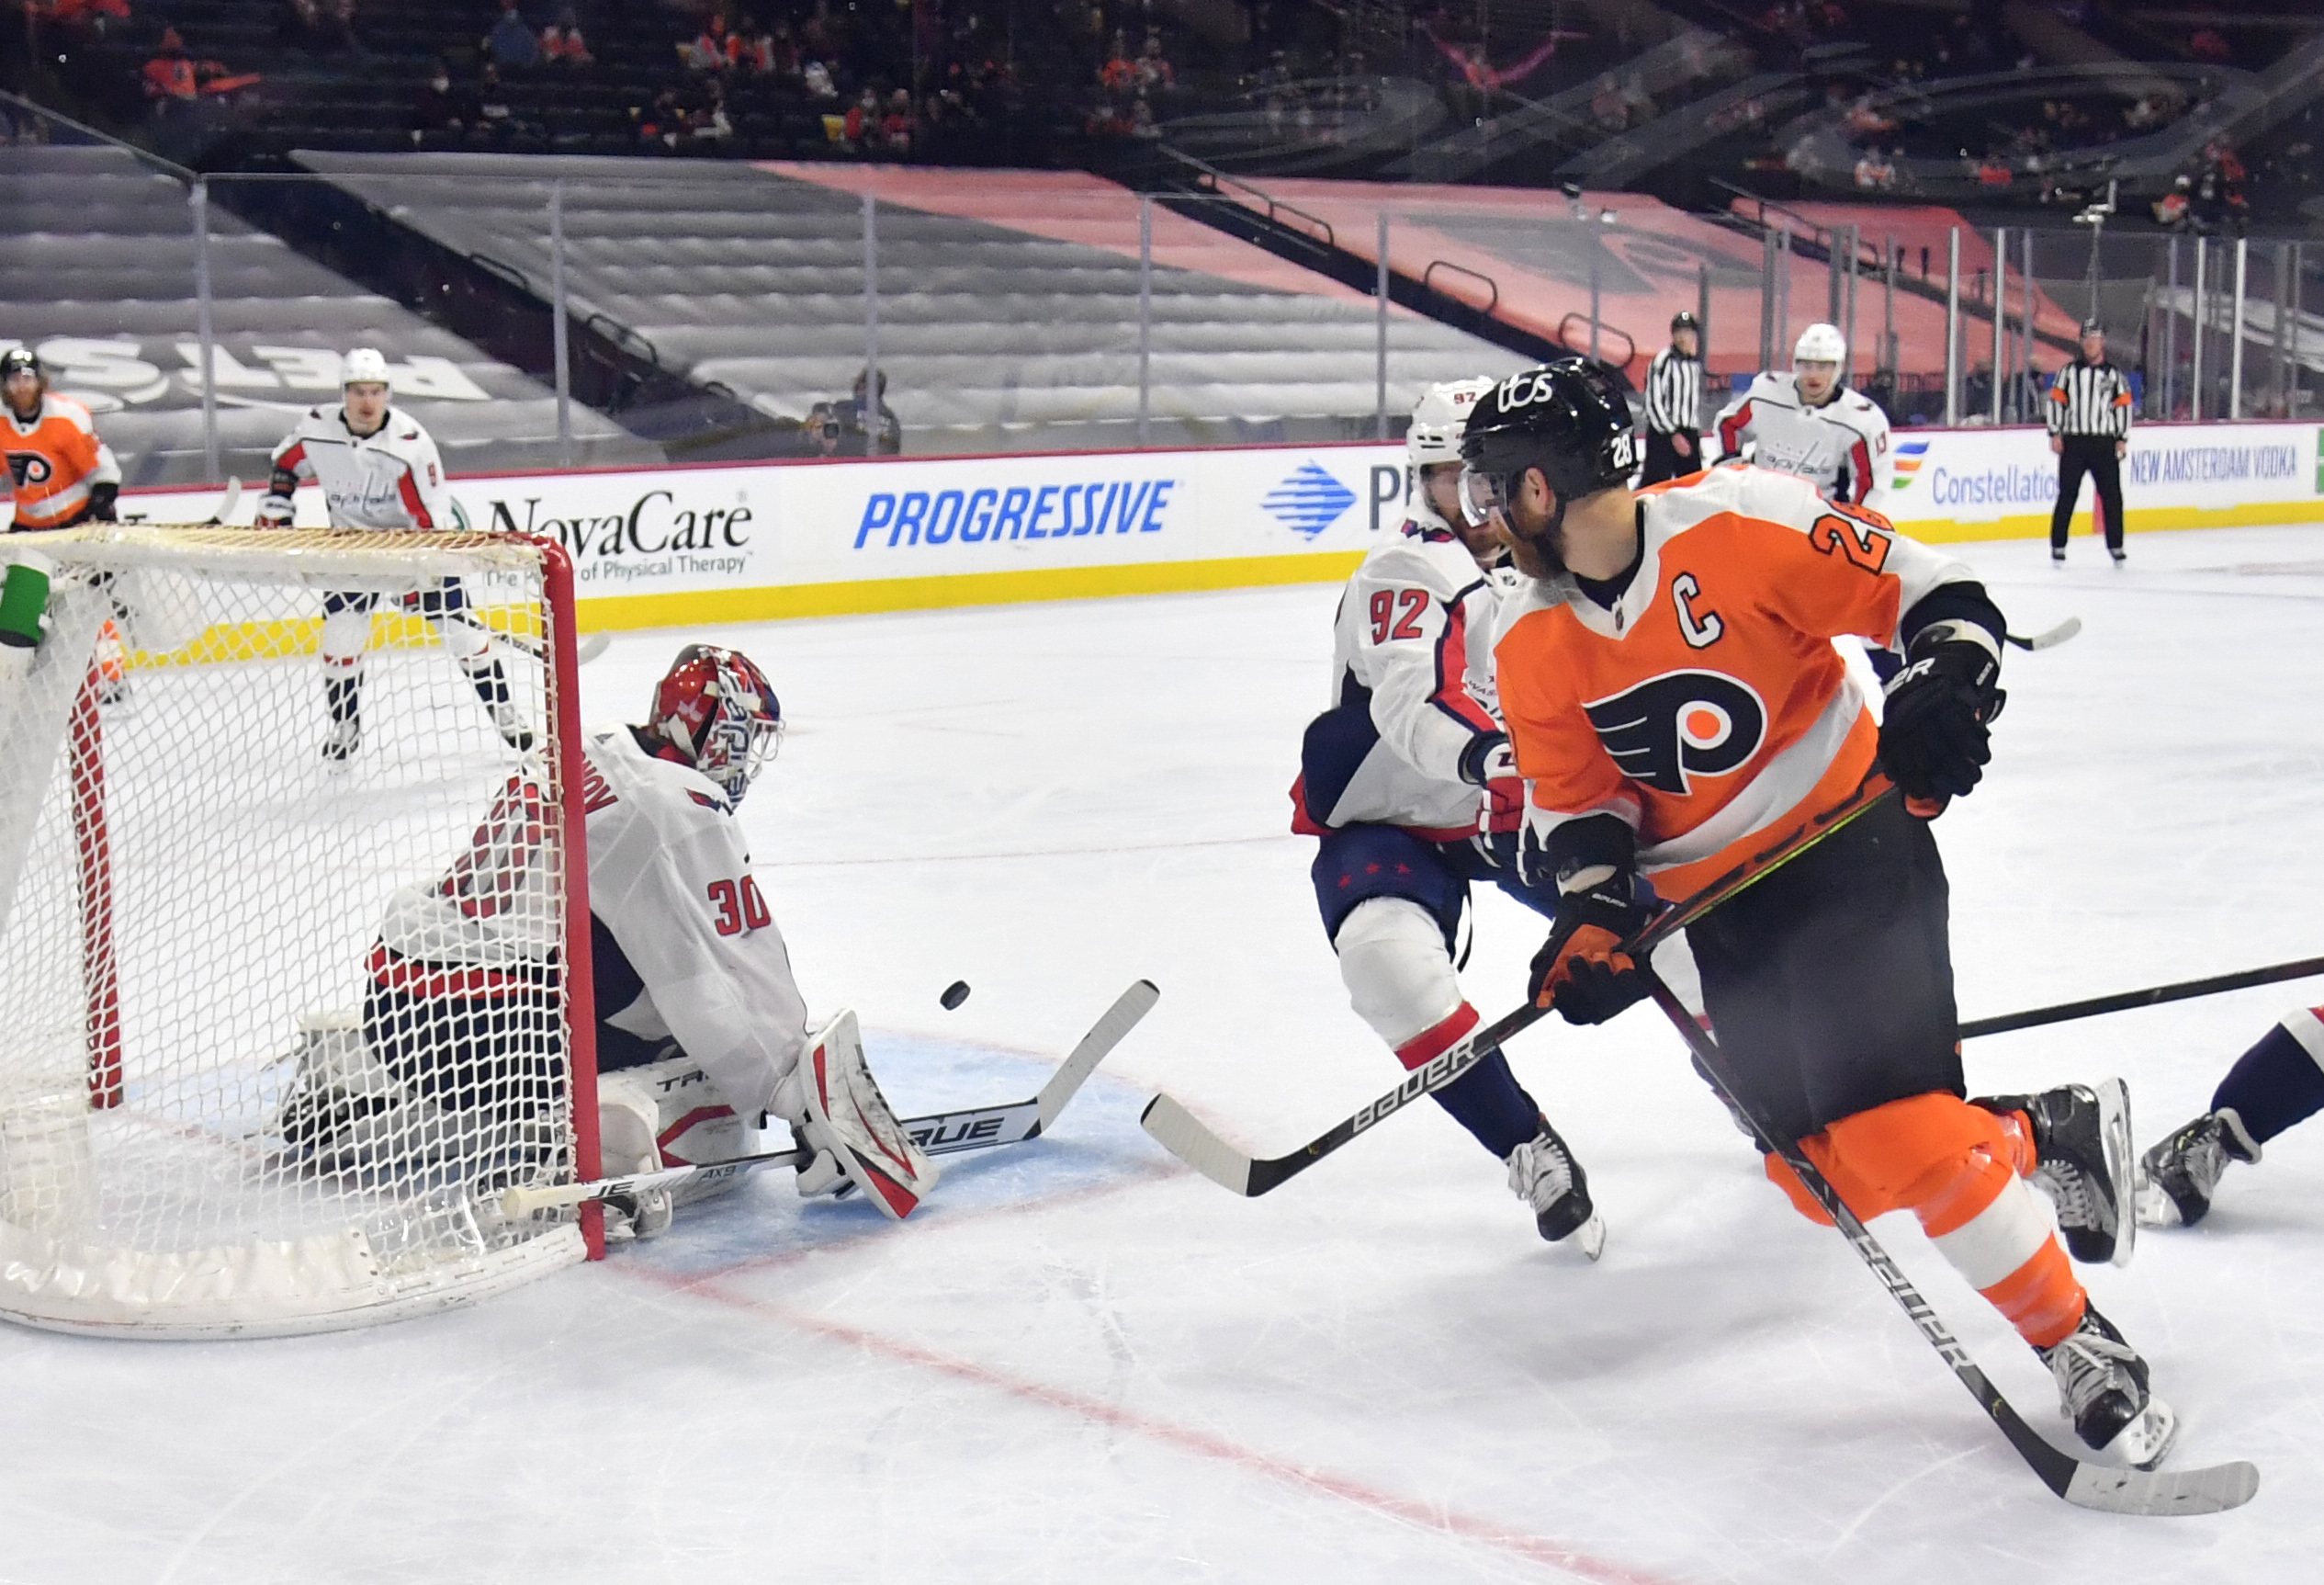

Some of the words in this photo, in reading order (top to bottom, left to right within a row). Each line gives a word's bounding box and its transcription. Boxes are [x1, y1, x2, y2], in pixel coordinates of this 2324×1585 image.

[1611, 433, 1634, 469] 28
[2130, 450, 2160, 484] NEW
[2162, 447, 2250, 483] AMSTERDAM
[2253, 445, 2297, 480] VODKA
[1933, 465, 2059, 504] Constellatio
[489, 490, 753, 558] NovaCare
[852, 480, 1175, 549] PROGRESSIVE
[581, 561, 598, 581] of
[603, 557, 673, 583] Physical
[1370, 588, 1429, 646] 92
[1671, 572, 1725, 649] C
[707, 874, 771, 936] 30
[908, 1115, 1005, 1146] RUE
